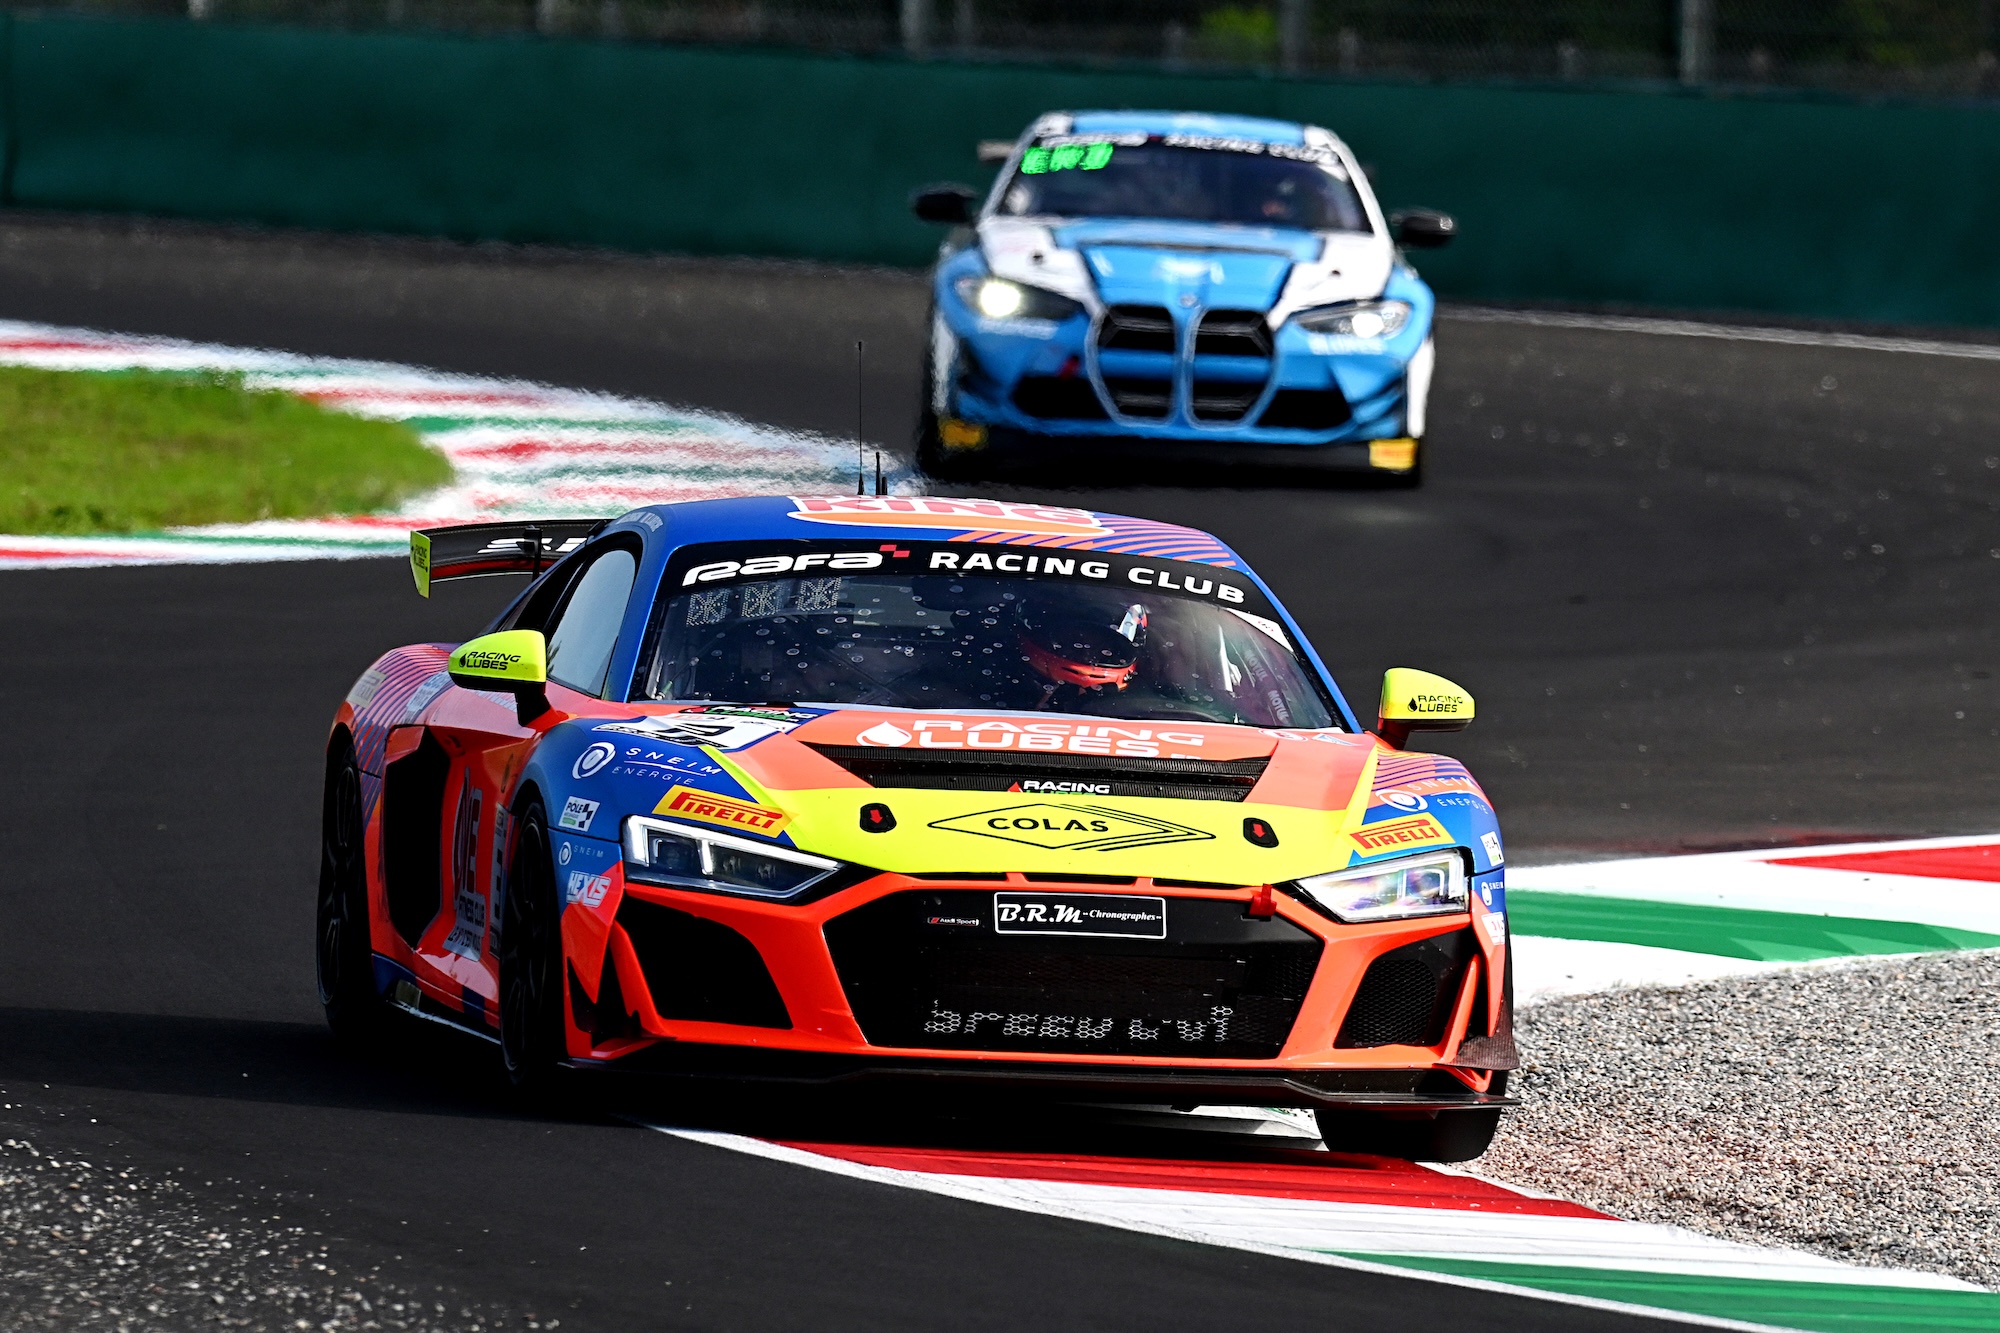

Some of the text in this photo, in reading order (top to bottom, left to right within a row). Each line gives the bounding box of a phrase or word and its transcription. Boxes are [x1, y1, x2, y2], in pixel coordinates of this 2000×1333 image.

[929, 551, 1110, 579] RACING
[1127, 567, 1246, 604] CLUB
[466, 658, 509, 671] LUBES
[467, 651, 521, 663] RACING
[1417, 694, 1463, 704] RACING
[1418, 703, 1458, 713] LUBES
[912, 719, 1205, 746] RACING
[918, 731, 1160, 757] LUBES
[625, 747, 723, 775] SNEIM
[1023, 780, 1110, 794] RACING
[668, 791, 783, 829] PIRELLI
[987, 817, 1109, 833] COLAS
[1349, 818, 1440, 849] PIRELLI
[573, 845, 604, 858] SNEIM
[567, 872, 612, 906] HEXIS
[956, 918, 977, 926] Sport
